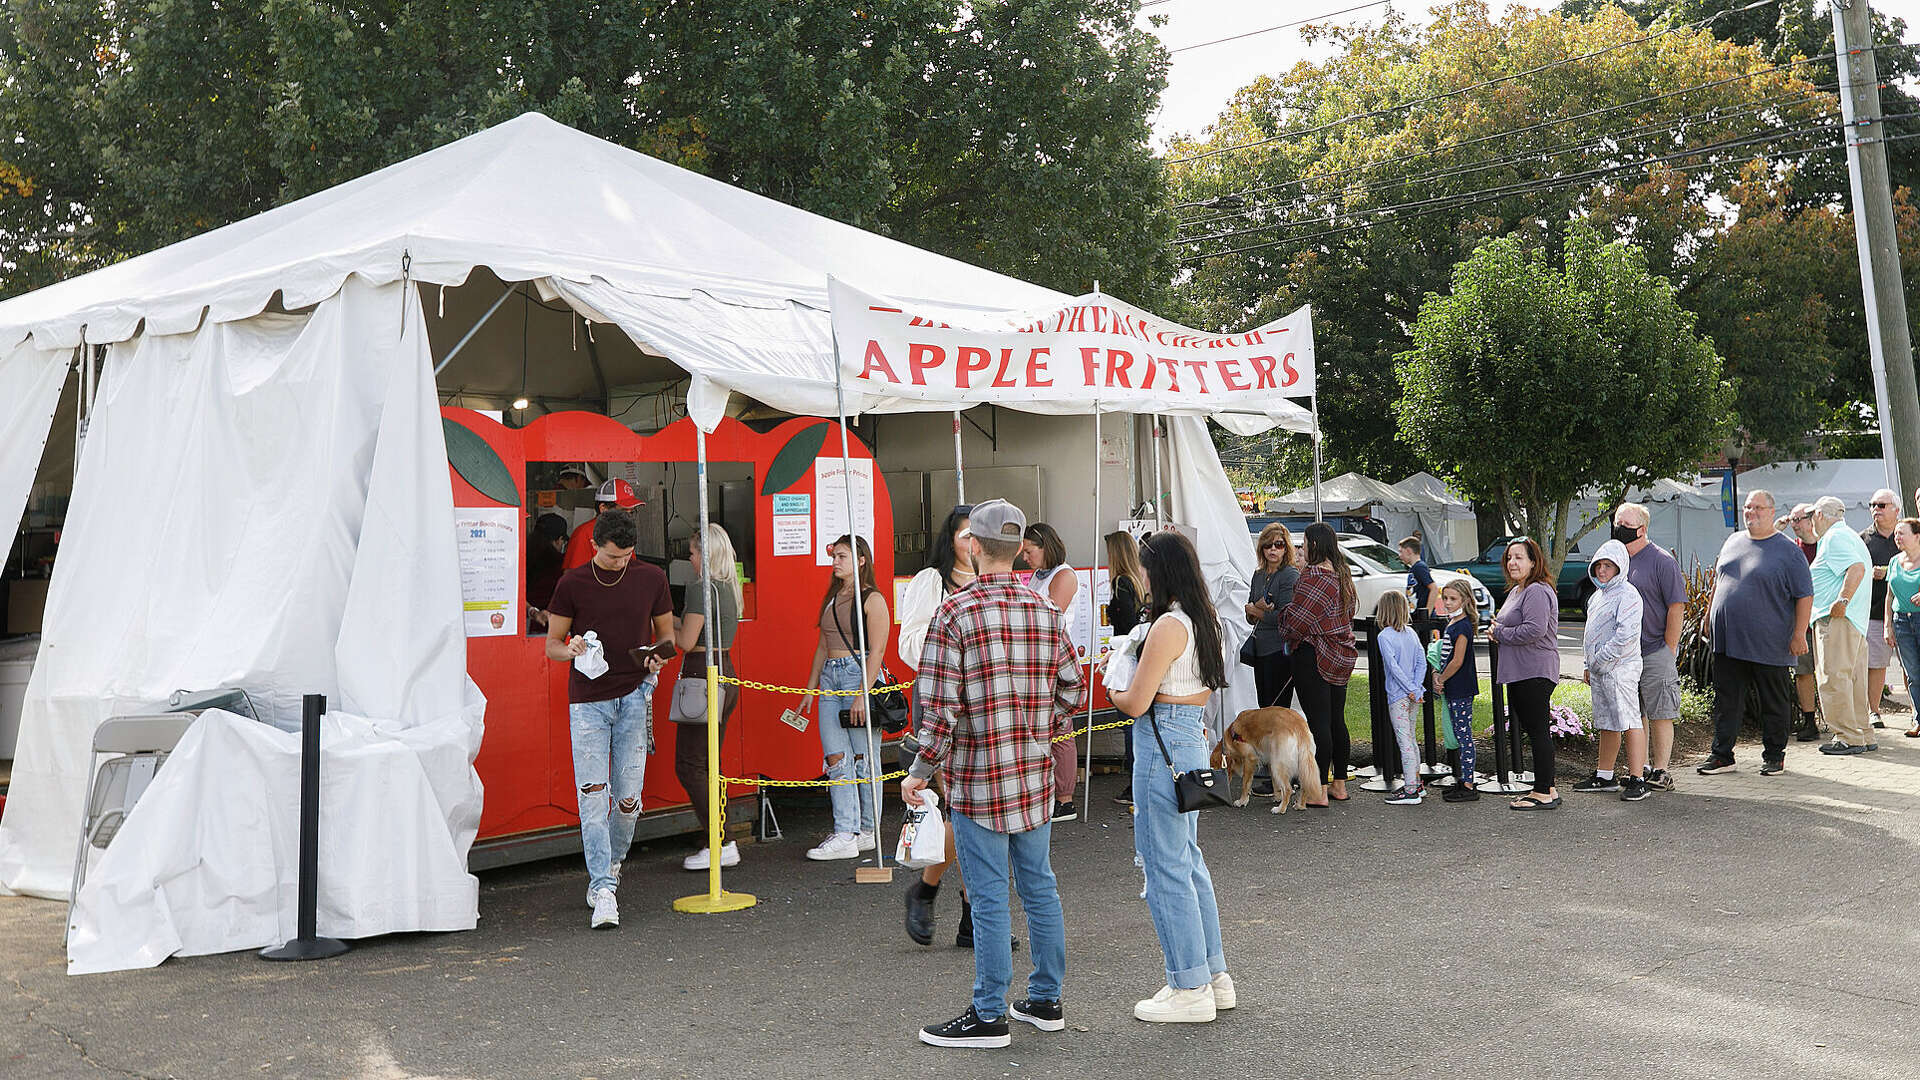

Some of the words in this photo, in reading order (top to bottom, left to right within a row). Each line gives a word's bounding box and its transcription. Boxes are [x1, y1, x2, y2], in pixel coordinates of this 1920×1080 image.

[1016, 306, 1150, 343] UTHER
[855, 341, 1054, 389] APPLE
[1078, 347, 1301, 394] FRITTERS
[470, 529, 486, 538] 2021
